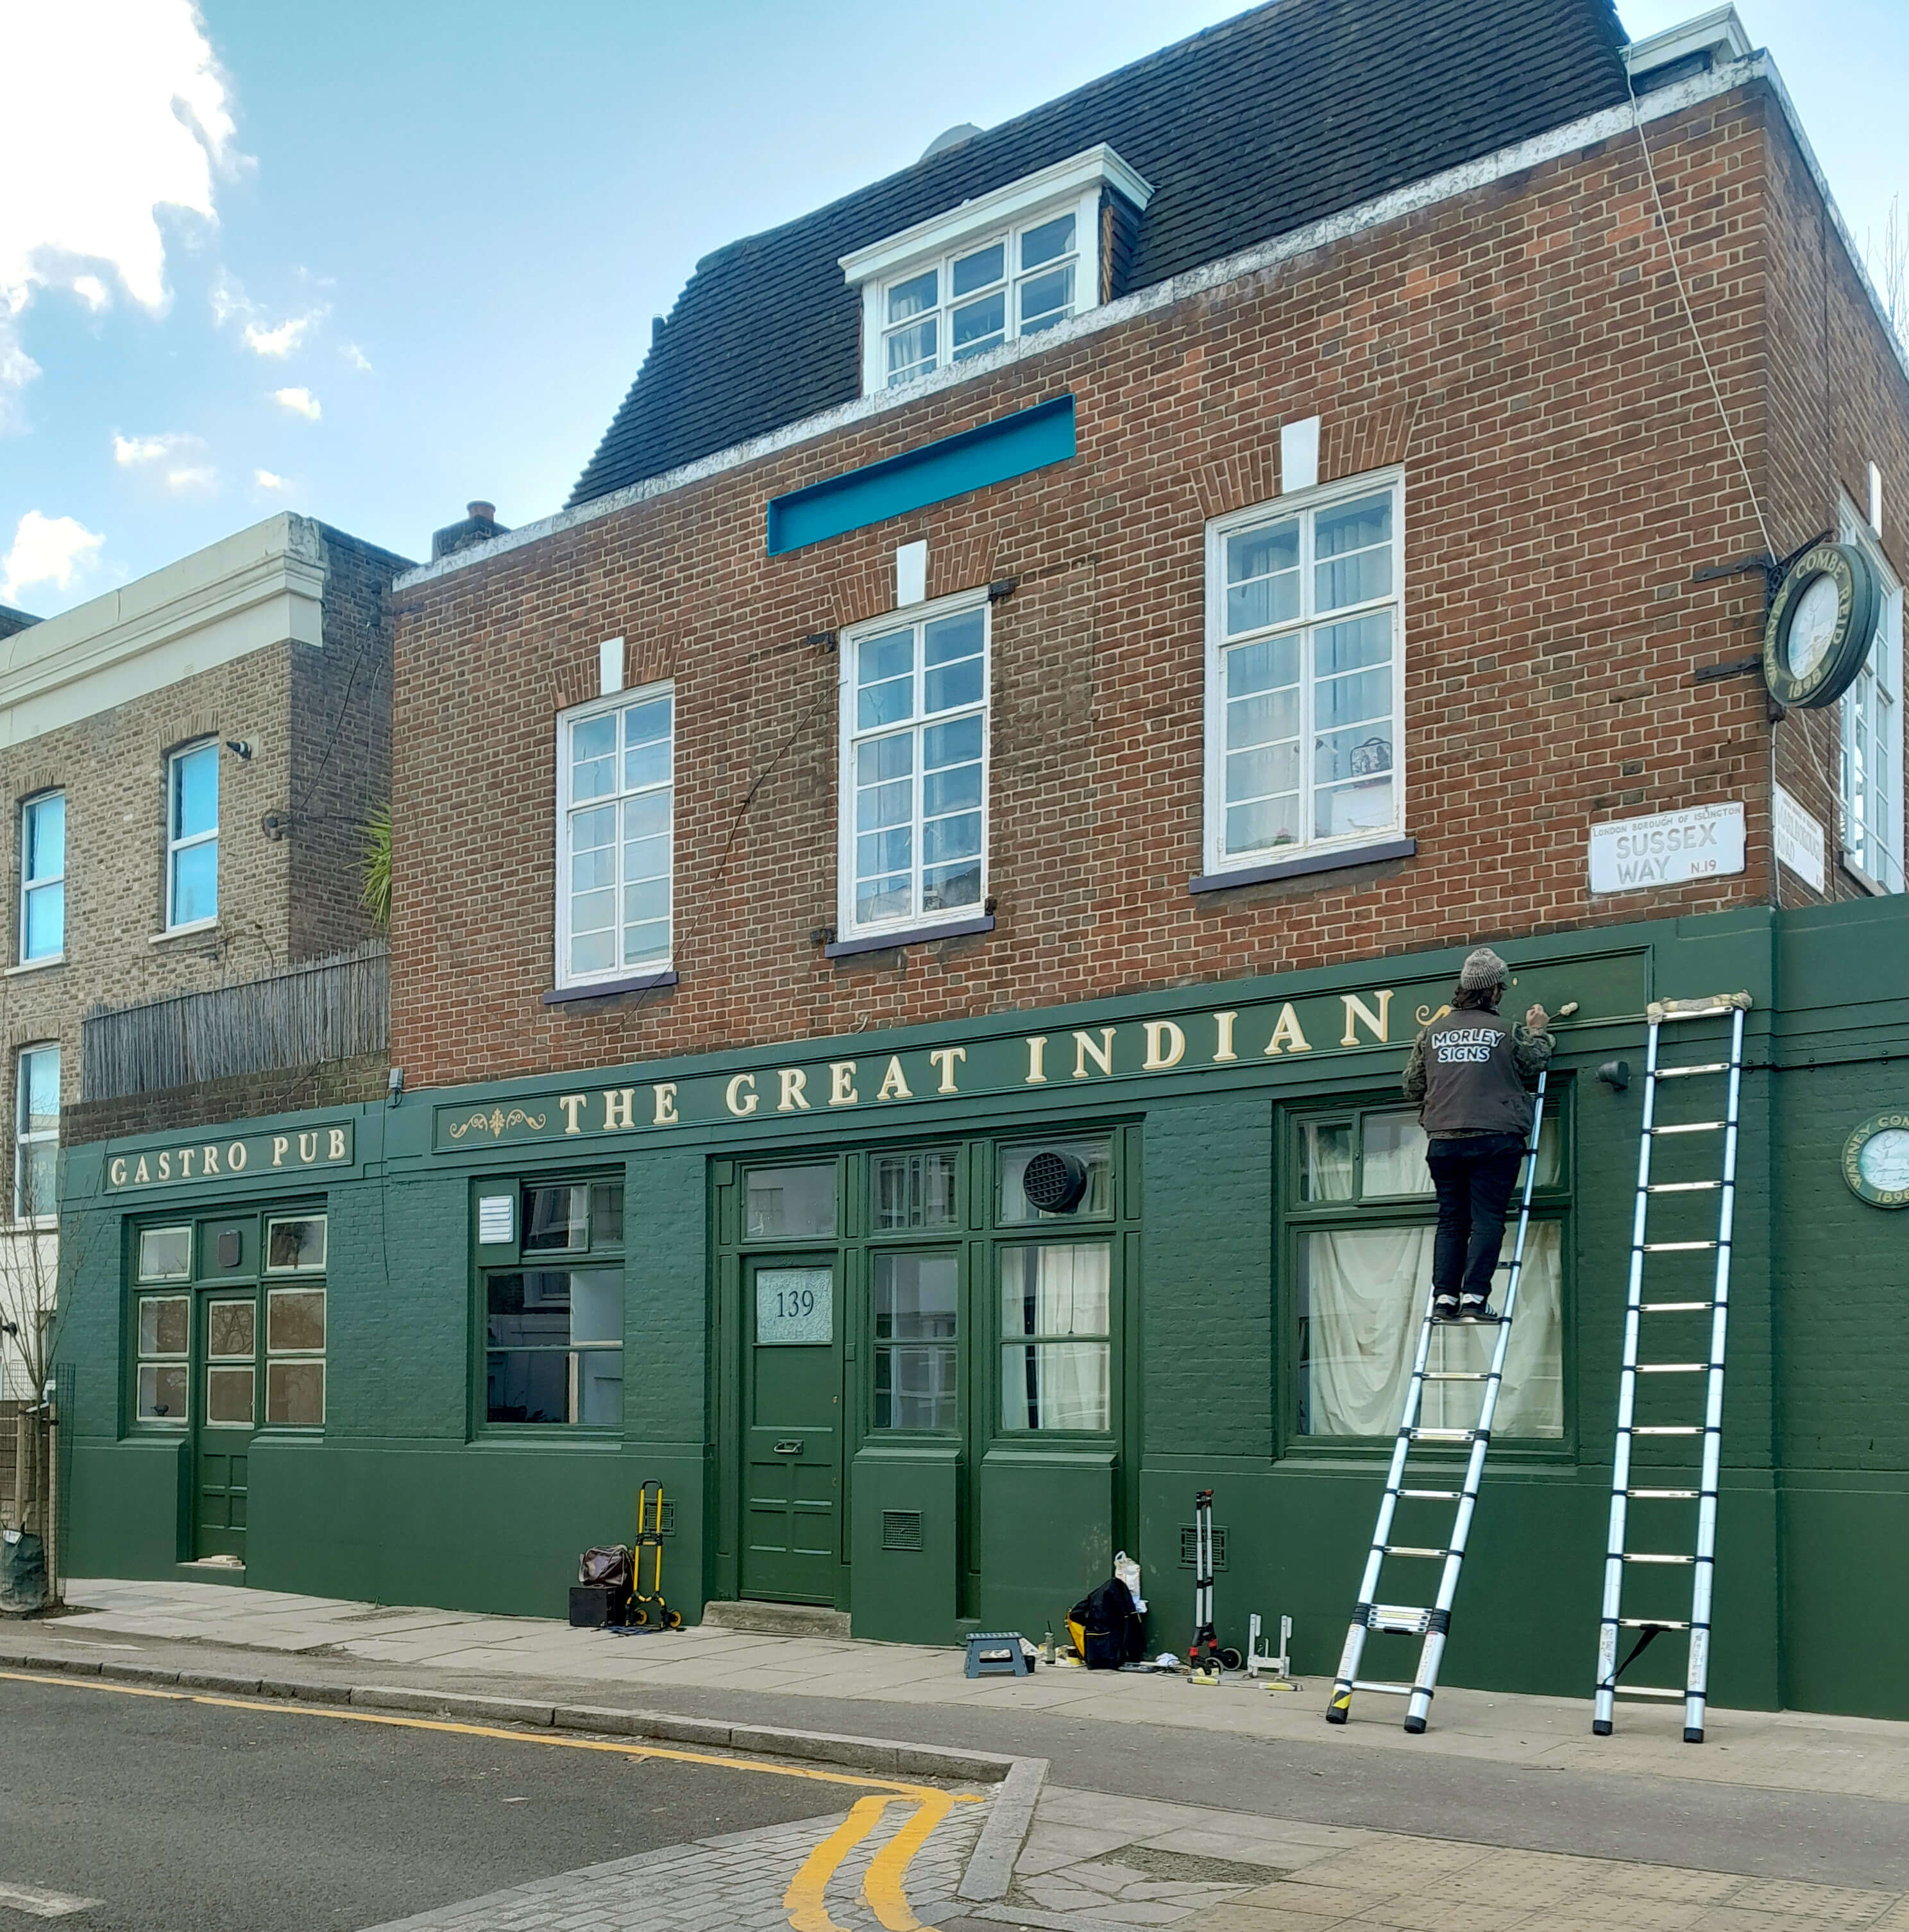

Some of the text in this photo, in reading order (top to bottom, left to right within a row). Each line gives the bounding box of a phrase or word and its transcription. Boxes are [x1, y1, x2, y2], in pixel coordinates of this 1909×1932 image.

[1796, 550, 1845, 580] COMBE
[1833, 584, 1853, 645] REID
[1788, 668, 1822, 699] 1898
[1593, 806, 1741, 837] LONDON BOROUGH OF ISLINGTON
[1616, 822, 1718, 860] SUSSEX
[1616, 855, 1671, 885] WAY
[1432, 1028, 1506, 1049] MORLEY
[1438, 1046, 1489, 1062] SIGNS
[559, 989, 1395, 1134] THE GREAT INDIAN
[110, 1128, 346, 1186] GASTRO PUB
[1845, 1123, 1871, 1190] WATNEY
[777, 1290, 814, 1318] 139
